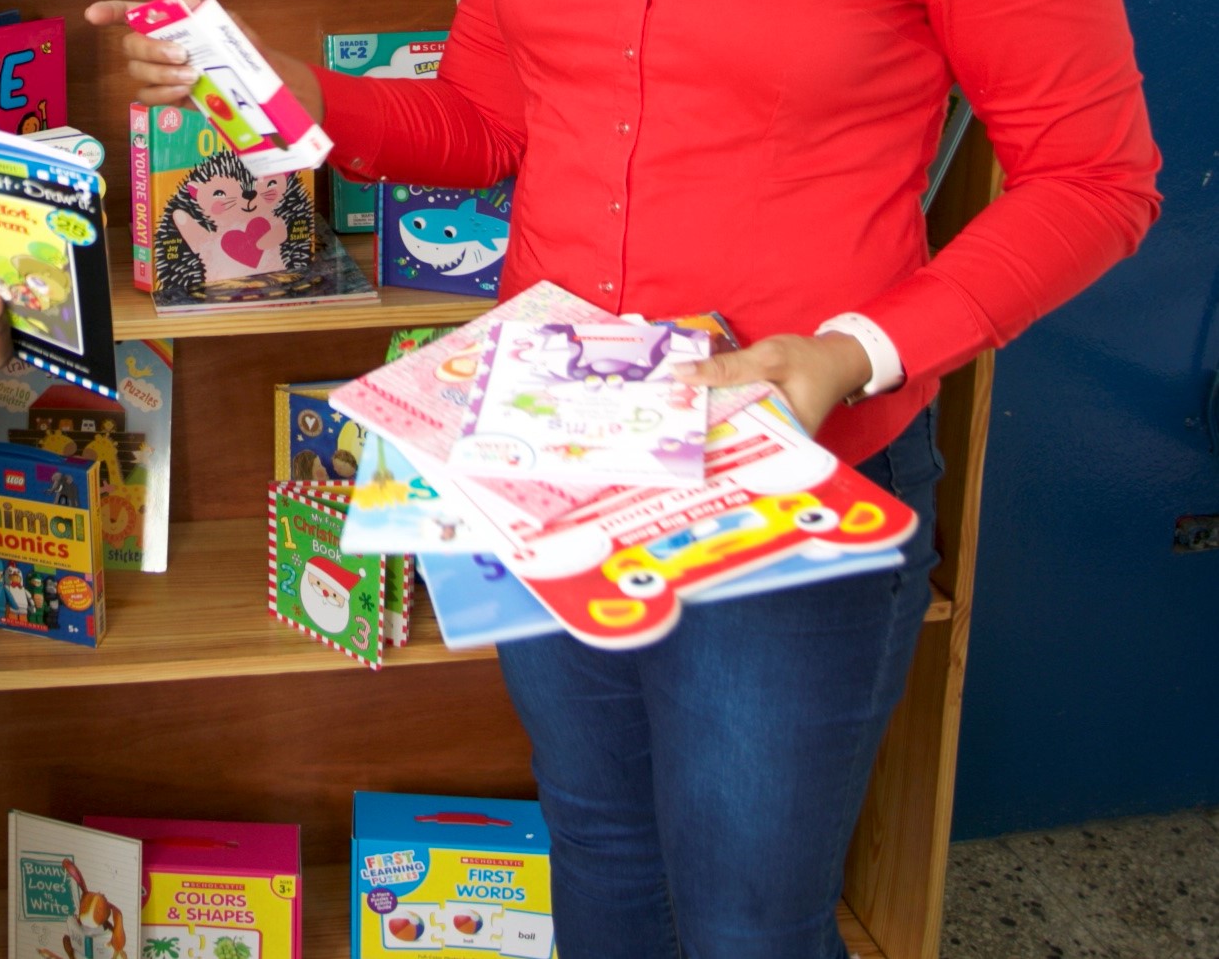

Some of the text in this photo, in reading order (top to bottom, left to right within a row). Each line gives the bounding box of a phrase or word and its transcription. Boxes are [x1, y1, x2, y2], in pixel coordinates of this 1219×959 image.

[22, 179, 77, 206] Draw
[135, 203, 149, 245] OKAY!
[166, 251, 179, 261] Cho
[167, 245, 179, 253] Joy
[123, 380, 160, 409] Puzzles
[5, 474, 26, 486] LEGO
[281, 516, 297, 550] 1
[312, 538, 342, 564] Book
[279, 563, 296, 597] 2
[68, 624, 79, 633] 5+
[351, 615, 371, 651] 3
[365, 852, 415, 869] FIRST
[468, 858, 523, 867] SCHOLASTIC
[24, 863, 68, 884] Bunny
[362, 862, 424, 878] LEARNING
[371, 871, 419, 885] PUZZLES
[468, 869, 515, 884] FIRST
[27, 878, 67, 894] Loves
[191, 882, 244, 890] SCHOLASTIC
[279, 885, 293, 894] 3+
[455, 884, 526, 901] WORDS
[43, 891, 54, 901] to
[175, 891, 247, 907] COLORS
[29, 897, 70, 916] Write
[167, 907, 255, 924] & SHAPES
[518, 931, 537, 941] ball
